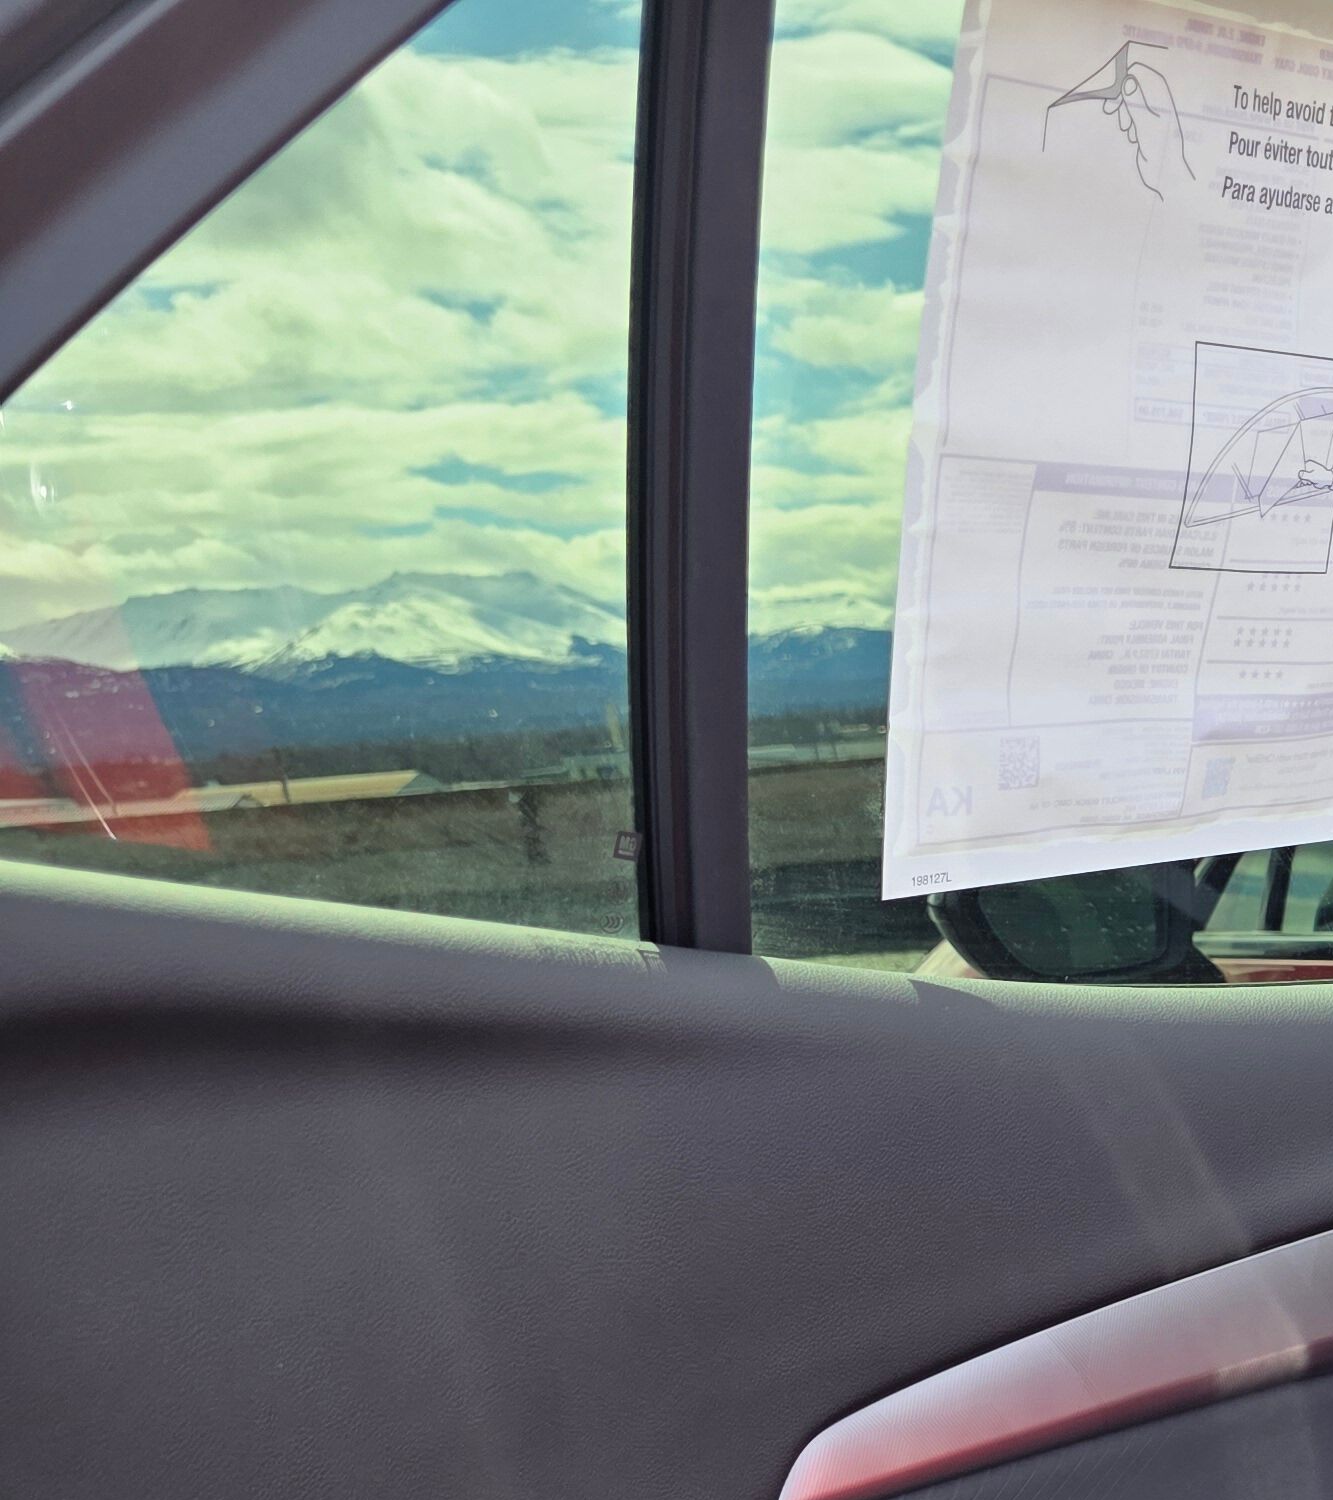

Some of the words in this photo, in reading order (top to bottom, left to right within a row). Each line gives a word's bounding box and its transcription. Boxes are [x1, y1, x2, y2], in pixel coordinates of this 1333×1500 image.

[1233, 85, 1249, 109] To
[1253, 88, 1282, 120] help
[1286, 100, 1326, 125] avoid
[1229, 131, 1261, 159] Pour
[1264, 136, 1303, 165] éviter
[1221, 176, 1255, 202] Para
[1259, 185, 1321, 213] ayudarse
[1324, 197, 1333, 215] a
[912, 872, 952, 887] 198127L
